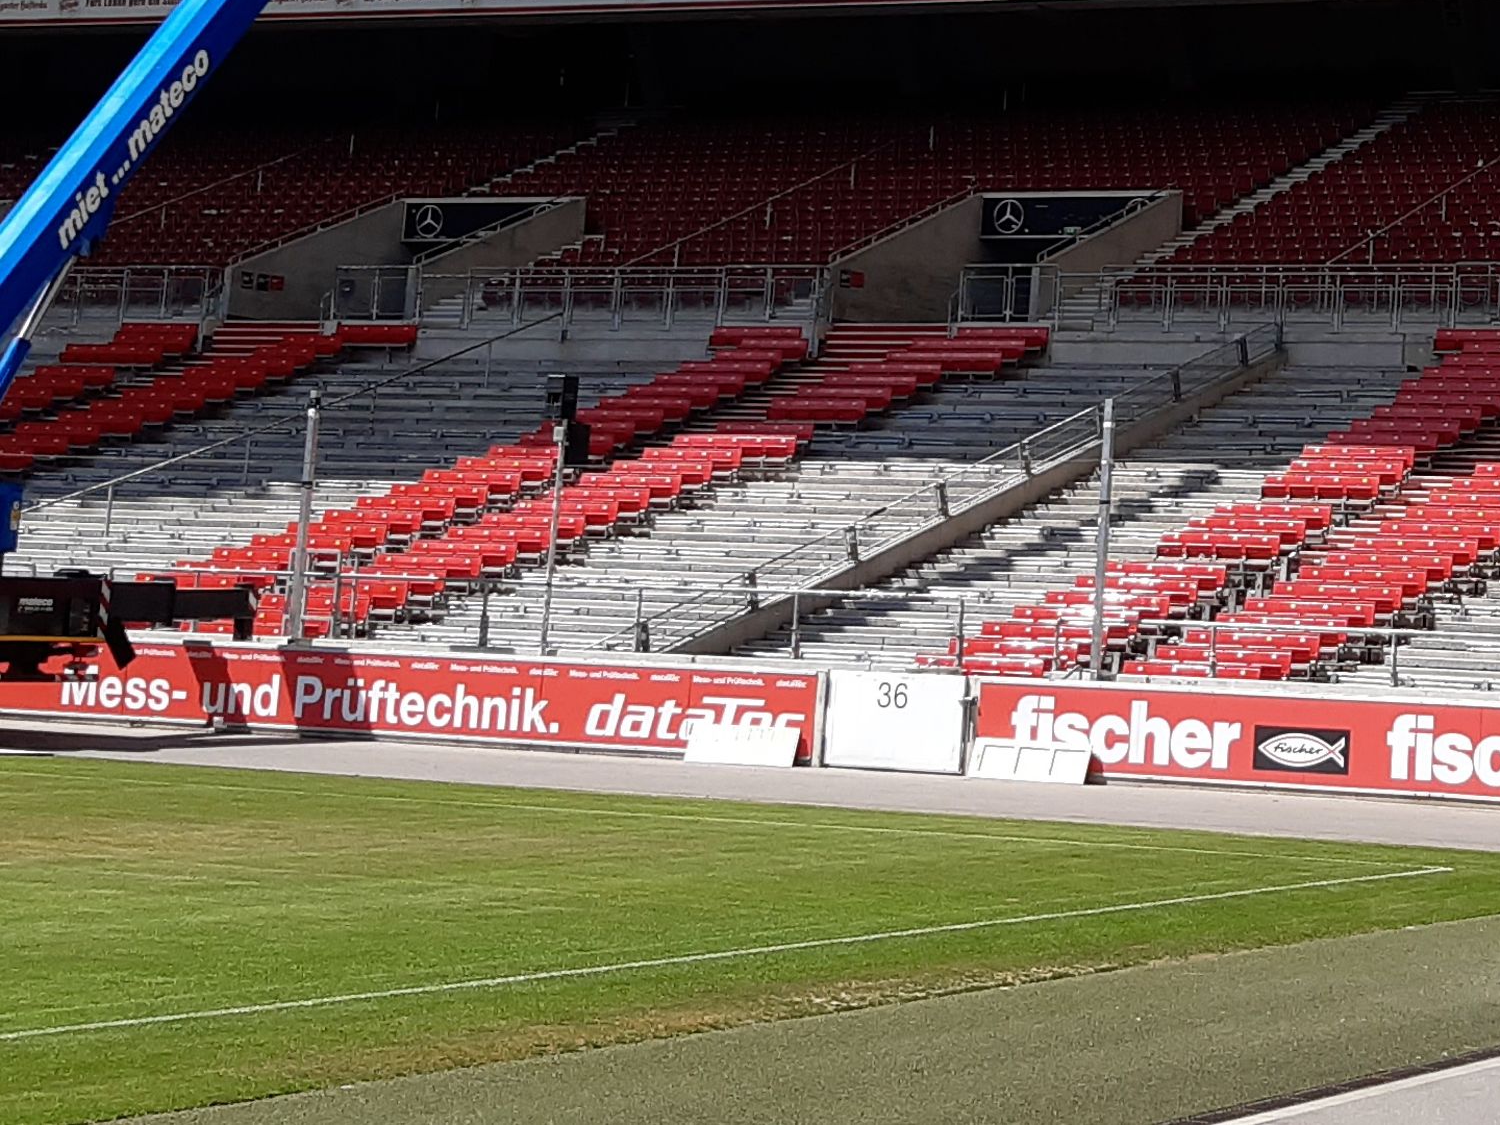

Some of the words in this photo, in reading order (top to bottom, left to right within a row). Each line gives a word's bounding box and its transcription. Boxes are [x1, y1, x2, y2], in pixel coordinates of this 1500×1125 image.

[58, 169, 109, 250] miet
[61, 664, 188, 711] Mess-
[202, 673, 281, 716] und
[294, 675, 559, 734] Prüftechnik.
[877, 682, 908, 708] 36
[1011, 695, 1242, 769] fischer
